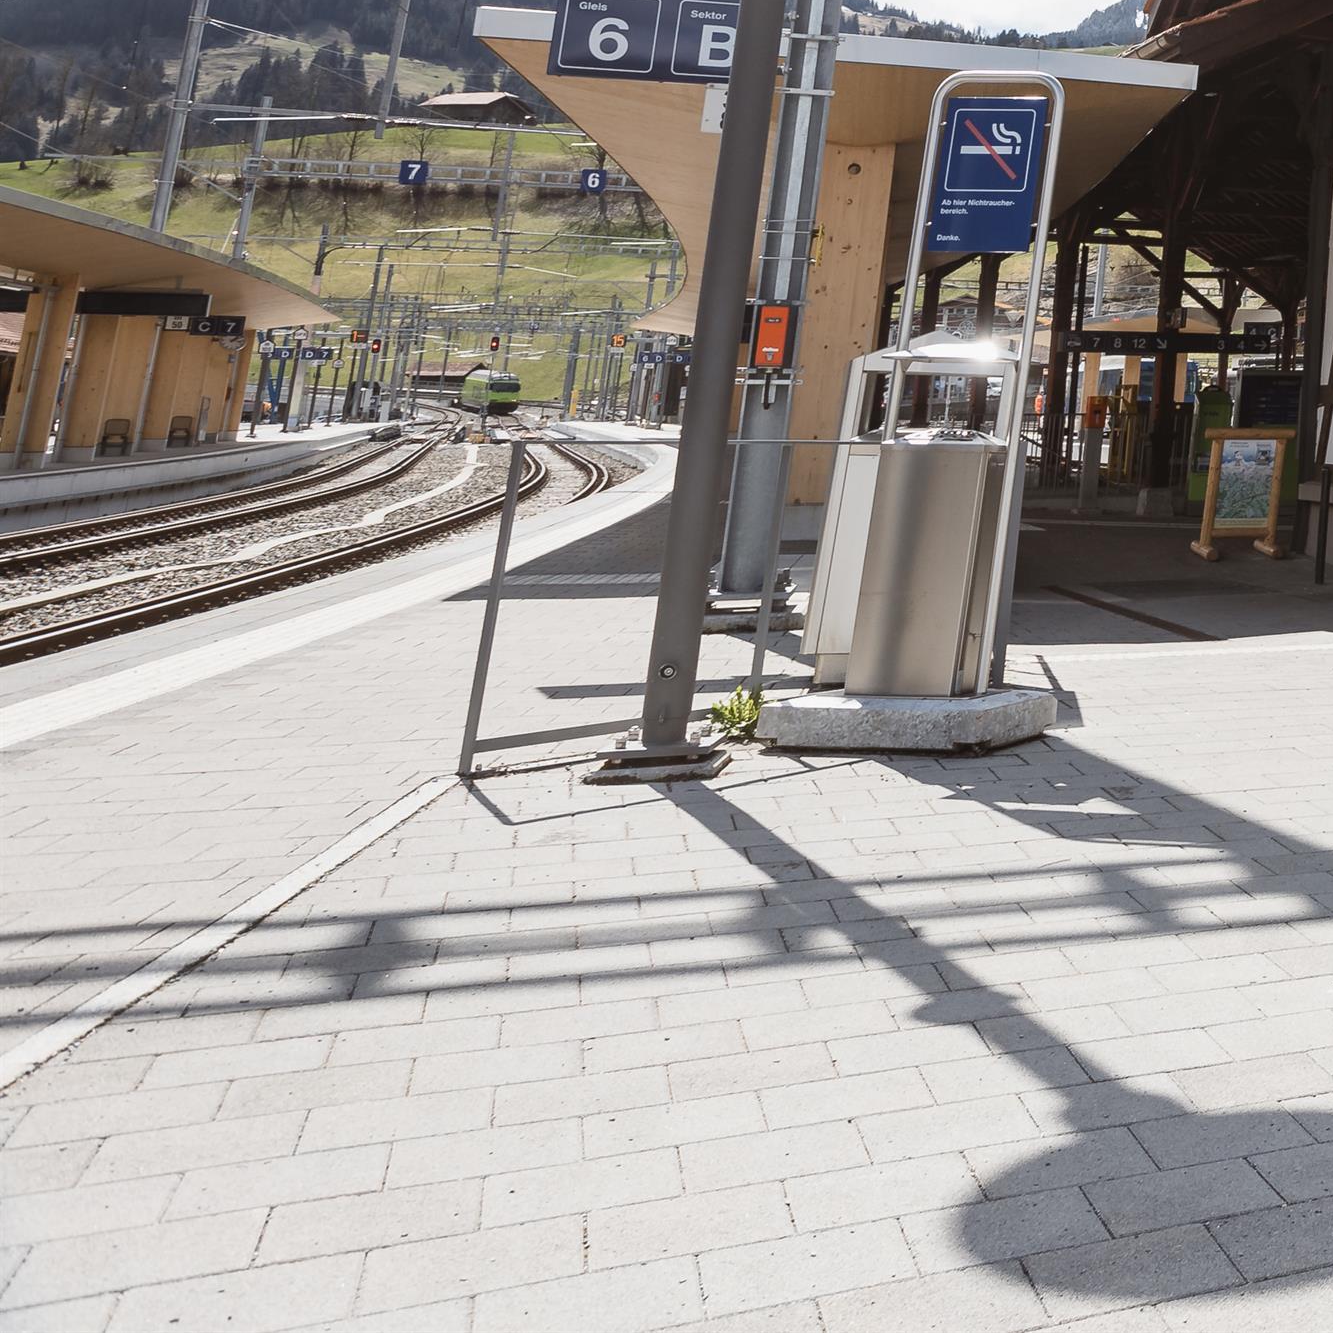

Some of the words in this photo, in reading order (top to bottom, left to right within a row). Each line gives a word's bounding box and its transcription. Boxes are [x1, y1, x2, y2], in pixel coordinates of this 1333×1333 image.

[579, 1, 608, 11] Gleis
[690, 9, 727, 21] Sektor
[588, 17, 630, 61] 6
[697, 24, 737, 68] B
[408, 164, 421, 180] 7
[587, 173, 600, 188] 6
[171, 321, 183, 329] 50
[198, 321, 211, 332] C
[227, 322, 236, 333] 7
[612, 334, 625, 347] 15
[1092, 338, 1100, 350] 7
[1114, 338, 1122, 349] 8
[1132, 338, 1147, 349] 12
[1217, 339, 1225, 350] 3
